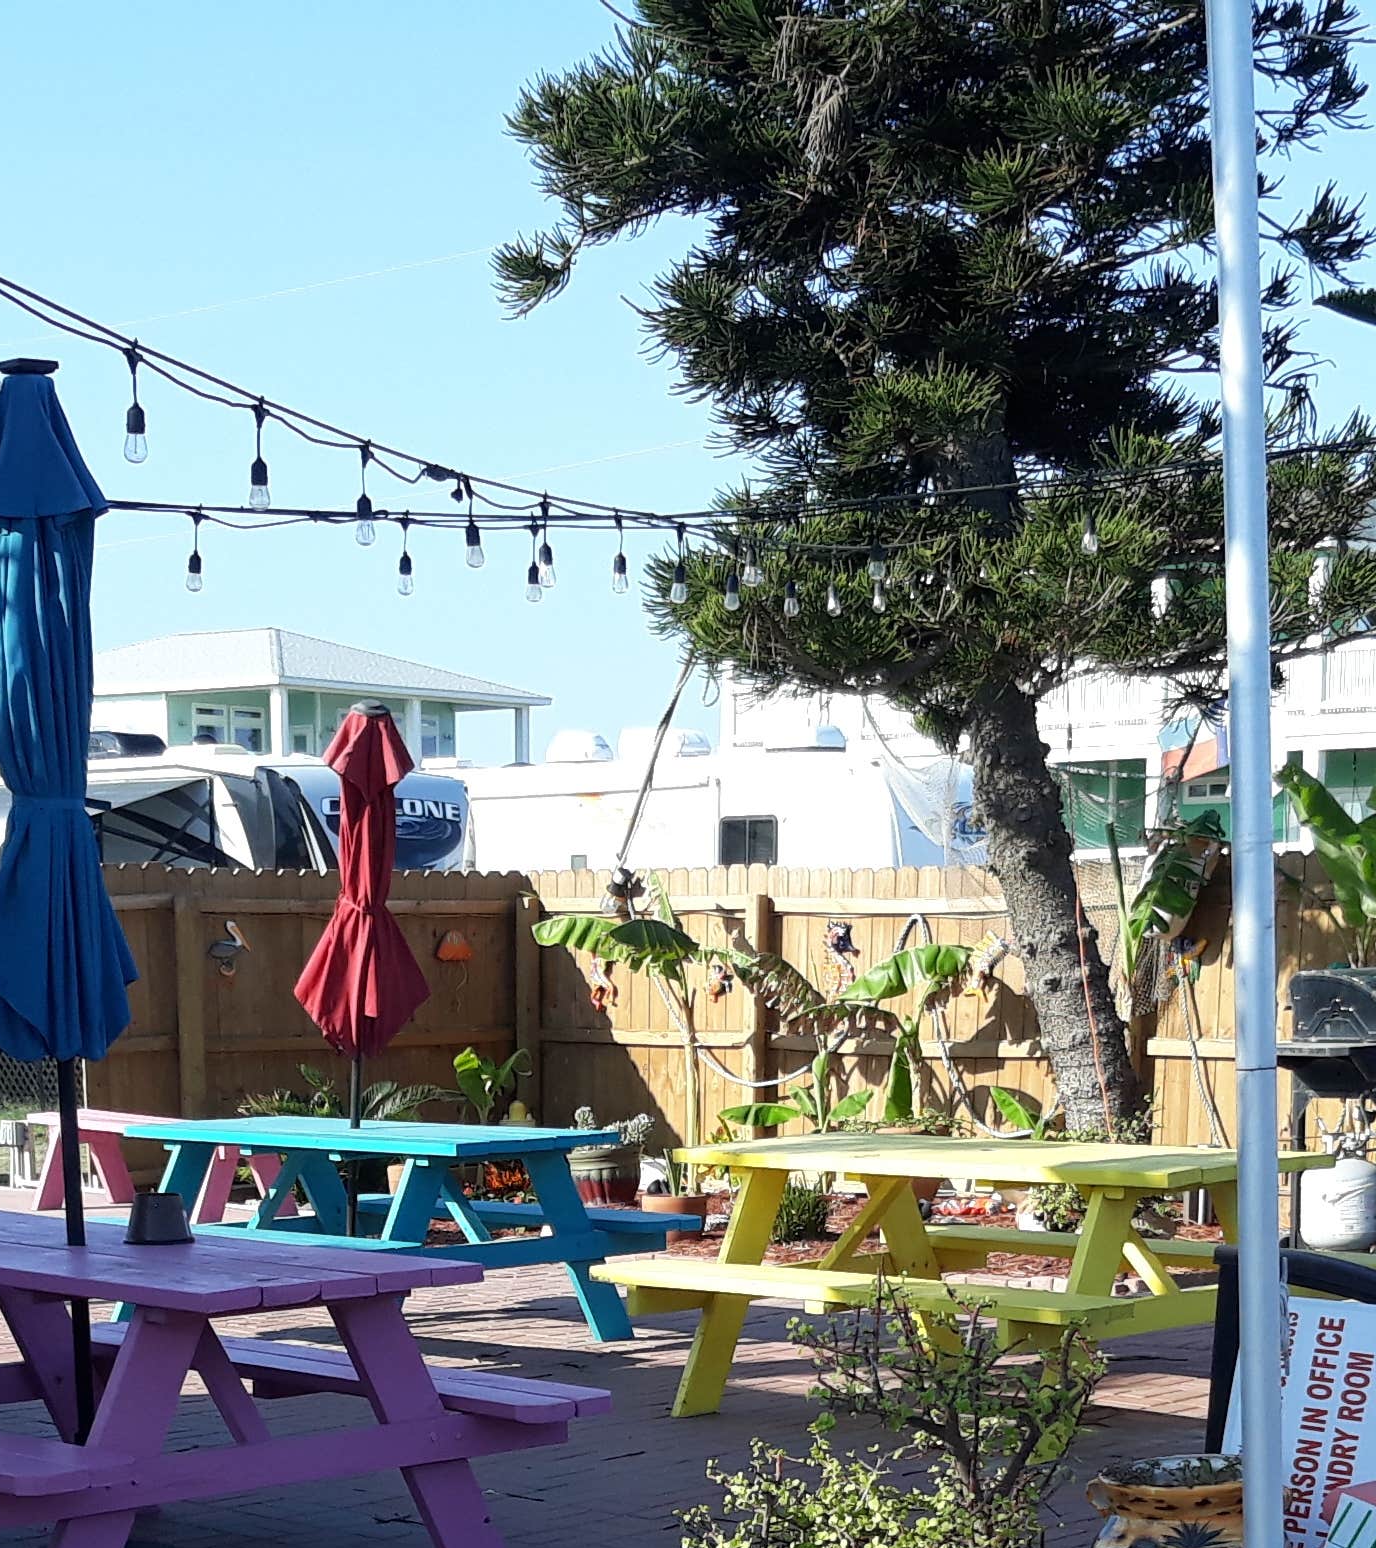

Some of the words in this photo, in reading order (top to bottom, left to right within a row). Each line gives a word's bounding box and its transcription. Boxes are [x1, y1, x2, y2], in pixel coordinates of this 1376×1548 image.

[321, 797, 461, 822] CONE
[1306, 1316, 1345, 1401] OFFICE
[1337, 1351, 1375, 1422] ROOM
[1299, 1406, 1328, 1433] IN
[1283, 1438, 1323, 1535] PERSON
